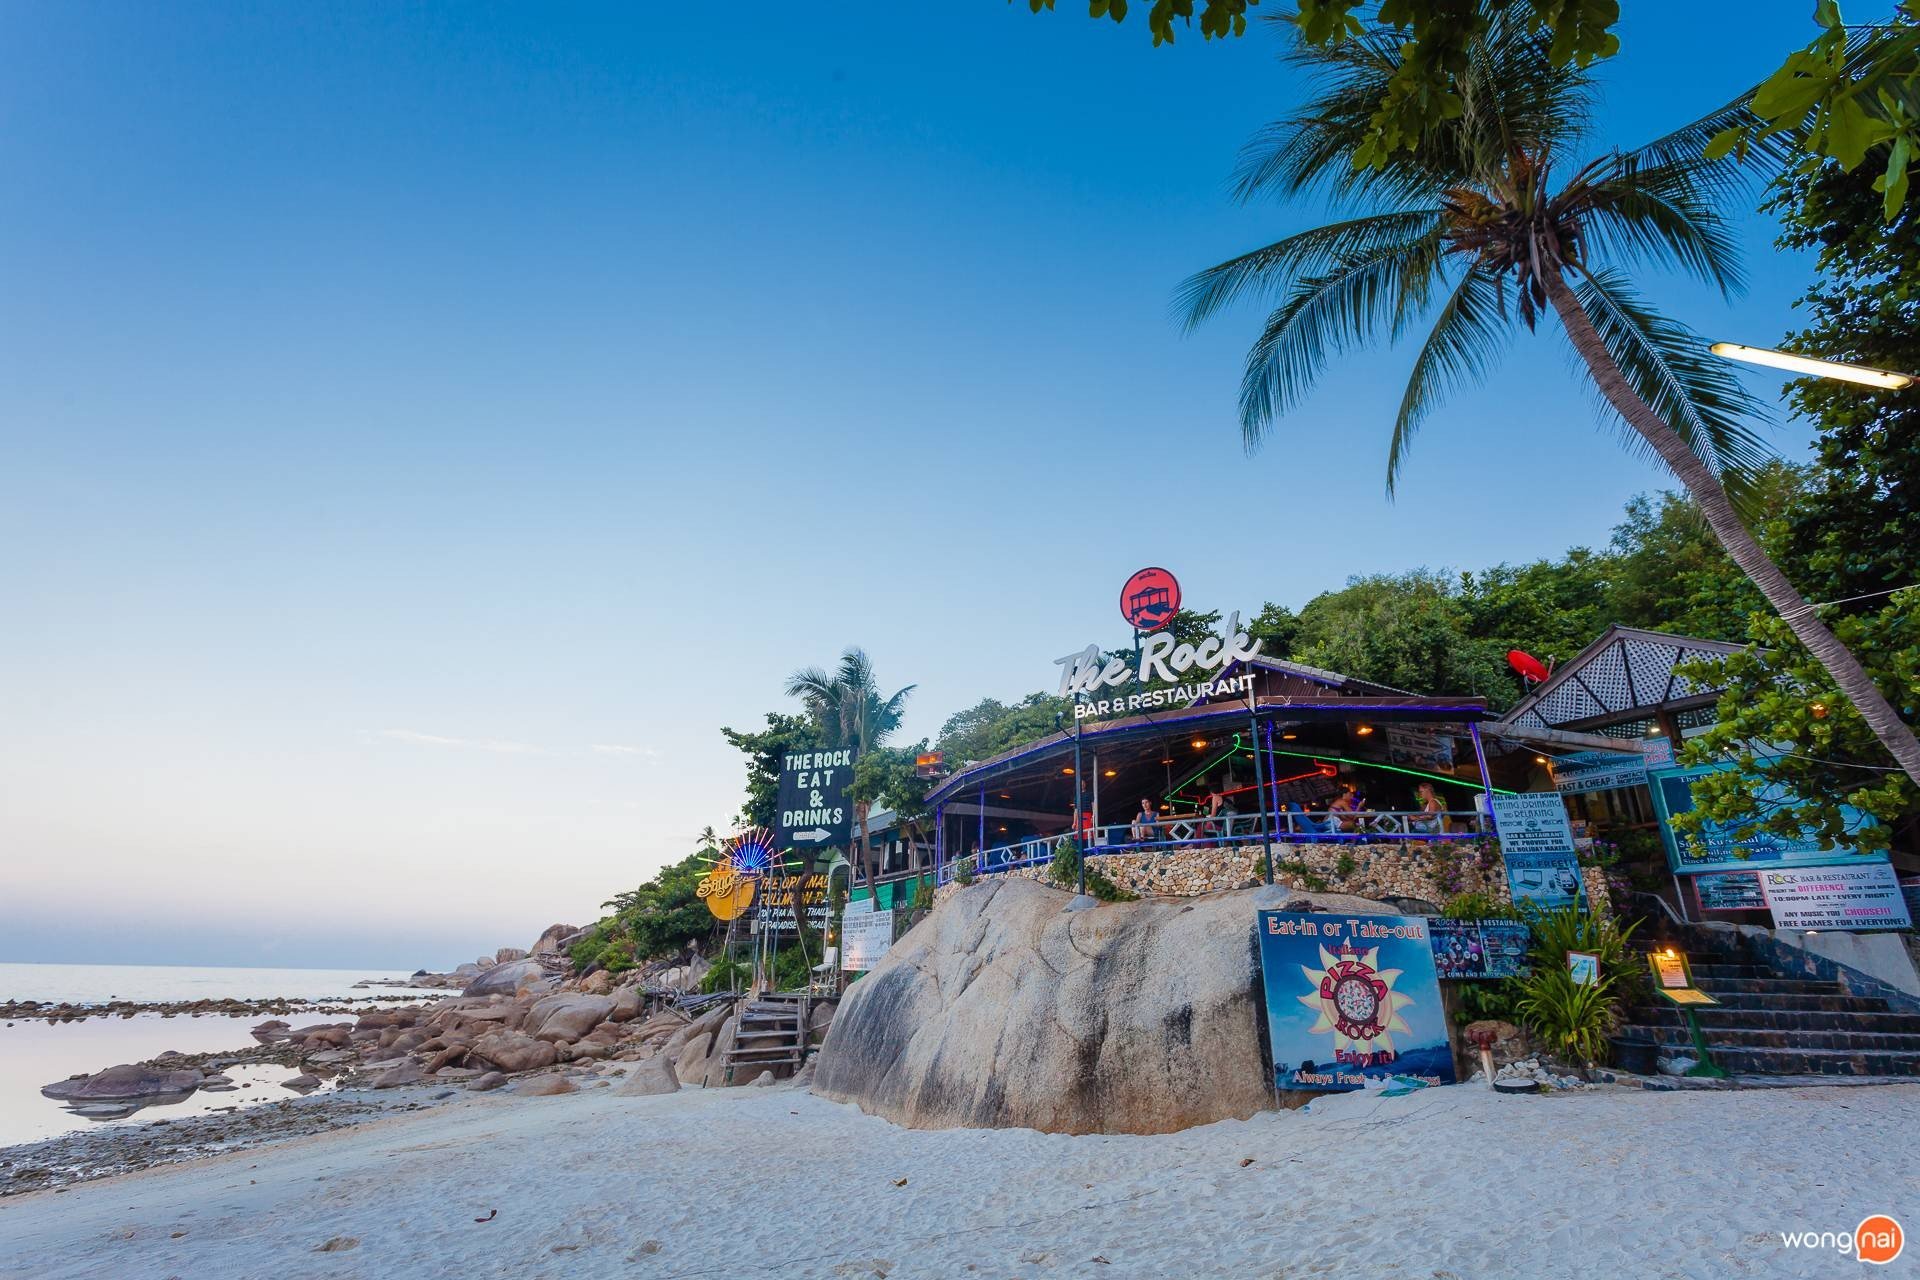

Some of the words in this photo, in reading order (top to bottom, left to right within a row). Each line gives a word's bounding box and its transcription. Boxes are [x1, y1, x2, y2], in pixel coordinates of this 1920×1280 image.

[1053, 644, 1132, 698] The
[1139, 610, 1263, 682] Rock
[1074, 700, 1110, 719] BAR
[1113, 698, 1126, 712] &
[1129, 674, 1256, 711] RESTAURANT
[785, 753, 811, 771] THE
[814, 750, 850, 769] ROCK
[797, 770, 834, 788] EAT
[1557, 782, 1576, 792] FAST
[809, 790, 823, 807] &
[783, 808, 842, 827] DRINKS
[1768, 872, 1798, 885] ROCK
[1822, 872, 1872, 881] RESTAURANT
[1797, 884, 1845, 892] DIFFERENCE
[1268, 916, 1318, 936] Eat-in
[1324, 922, 1341, 937] or
[1347, 920, 1424, 940] Take-out
[1801, 919, 1833, 927] GAMES
[1320, 960, 1388, 1001] PIZZA
[1335, 1016, 1386, 1041] ROCK
[1334, 1049, 1374, 1068] Enjoy
[1378, 1050, 1393, 1064] it!
[1293, 1071, 1333, 1085] Always
